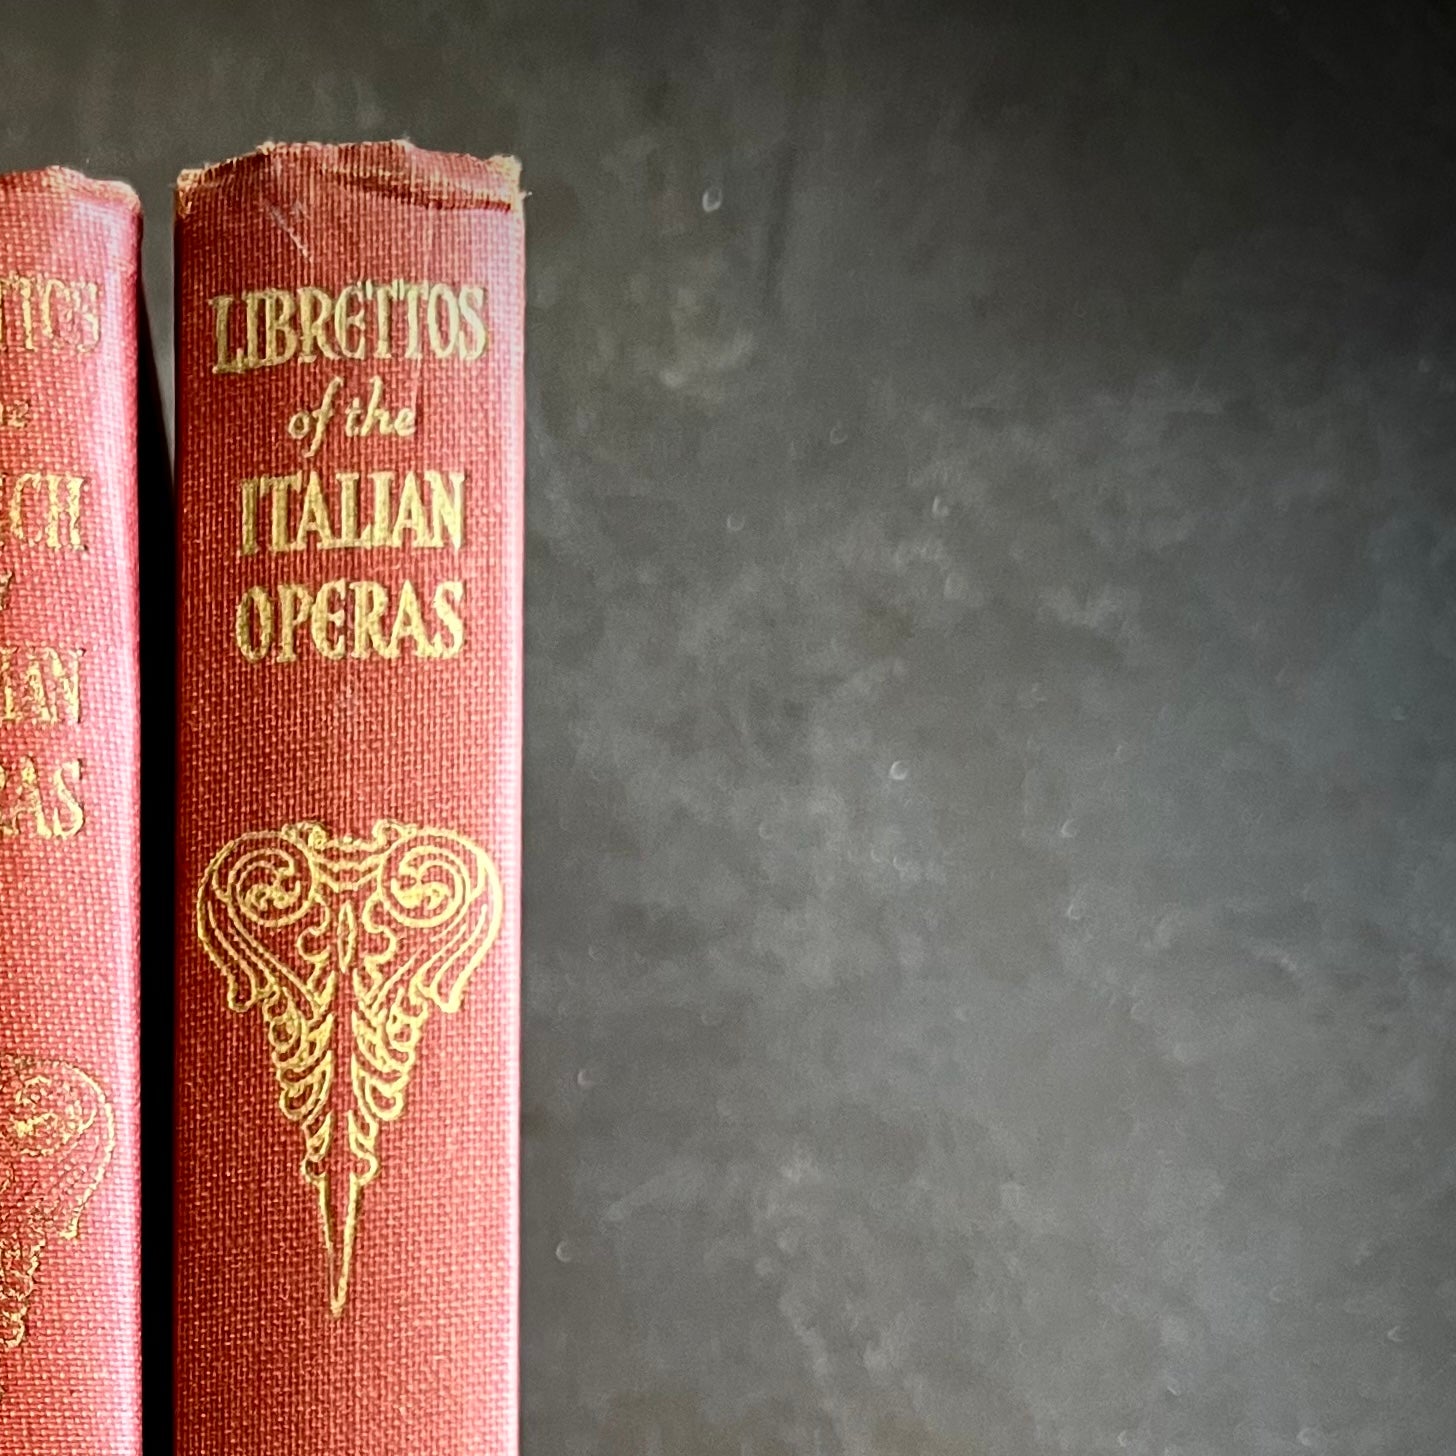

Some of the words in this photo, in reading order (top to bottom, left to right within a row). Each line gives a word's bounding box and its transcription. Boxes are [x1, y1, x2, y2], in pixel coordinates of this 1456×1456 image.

[209, 279, 488, 374] LIBRETTOS
[287, 376, 343, 458] of
[344, 375, 417, 438] the
[238, 470, 467, 556] ITALIAN
[235, 578, 466, 663] OPERAS
